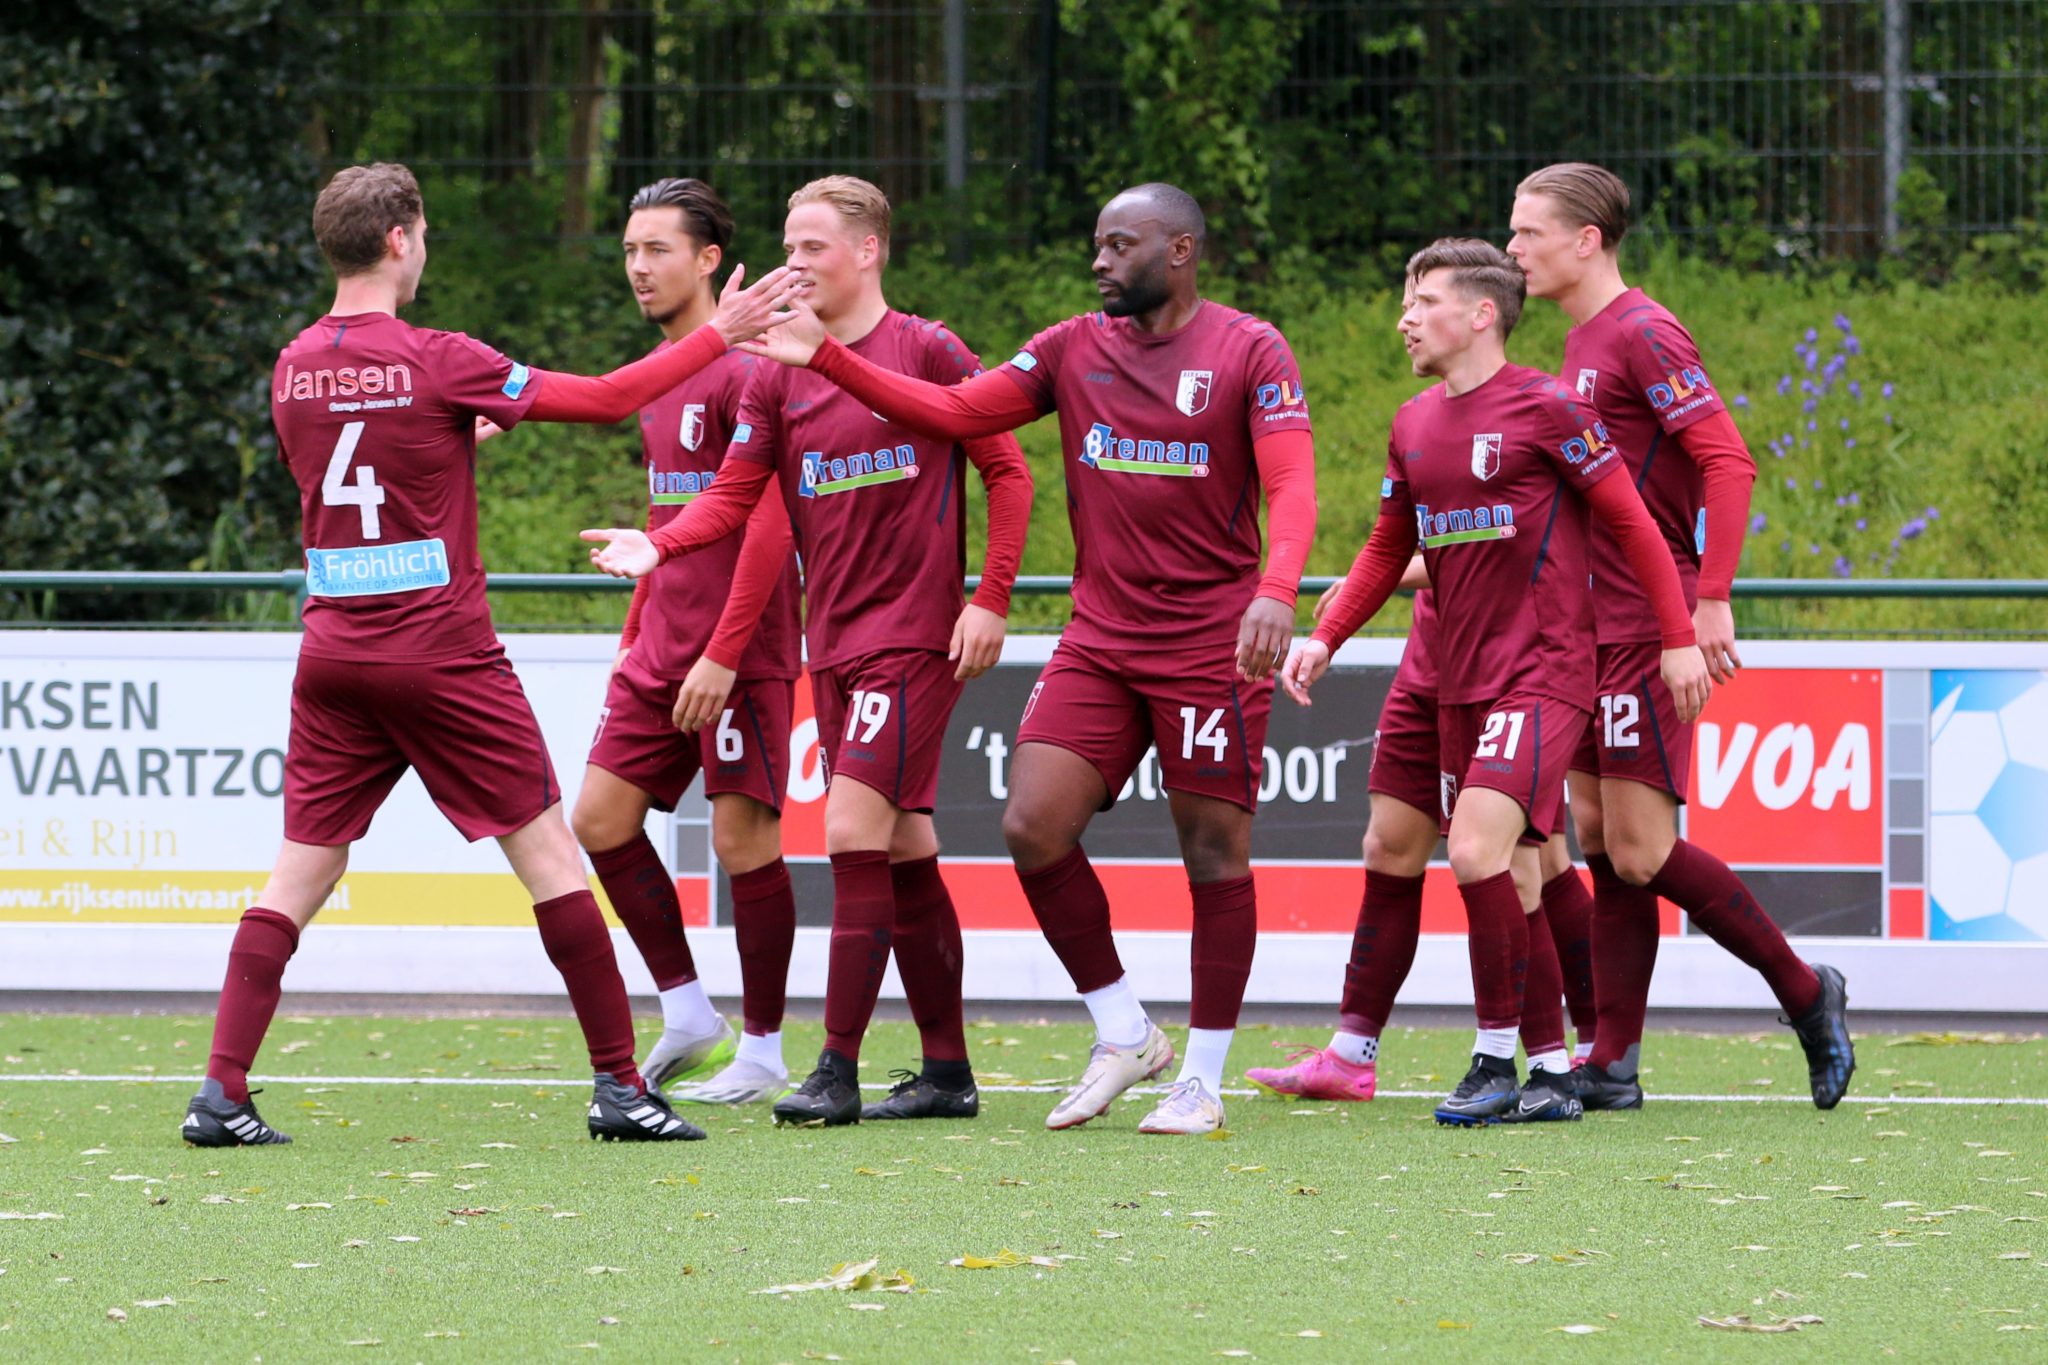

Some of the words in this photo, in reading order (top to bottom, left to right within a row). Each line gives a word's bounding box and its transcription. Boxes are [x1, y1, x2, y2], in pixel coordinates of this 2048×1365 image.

[277, 364, 412, 403] Jansen
[1646, 365, 1710, 409] DLH
[801, 444, 916, 488] Breman
[1084, 428, 1209, 464] Breman
[322, 421, 385, 539] 4
[325, 545, 443, 580] Fröhlich
[716, 708, 744, 762] 6
[846, 690, 891, 744] 19
[1180, 706, 1228, 762] 14
[1475, 711, 1525, 760] 21
[1601, 694, 1639, 747] 12
[0, 747, 284, 797] VAARTZO
[1697, 721, 1871, 811] VOA
[42, 817, 72, 857] &
[91, 819, 177, 868] Rijn
